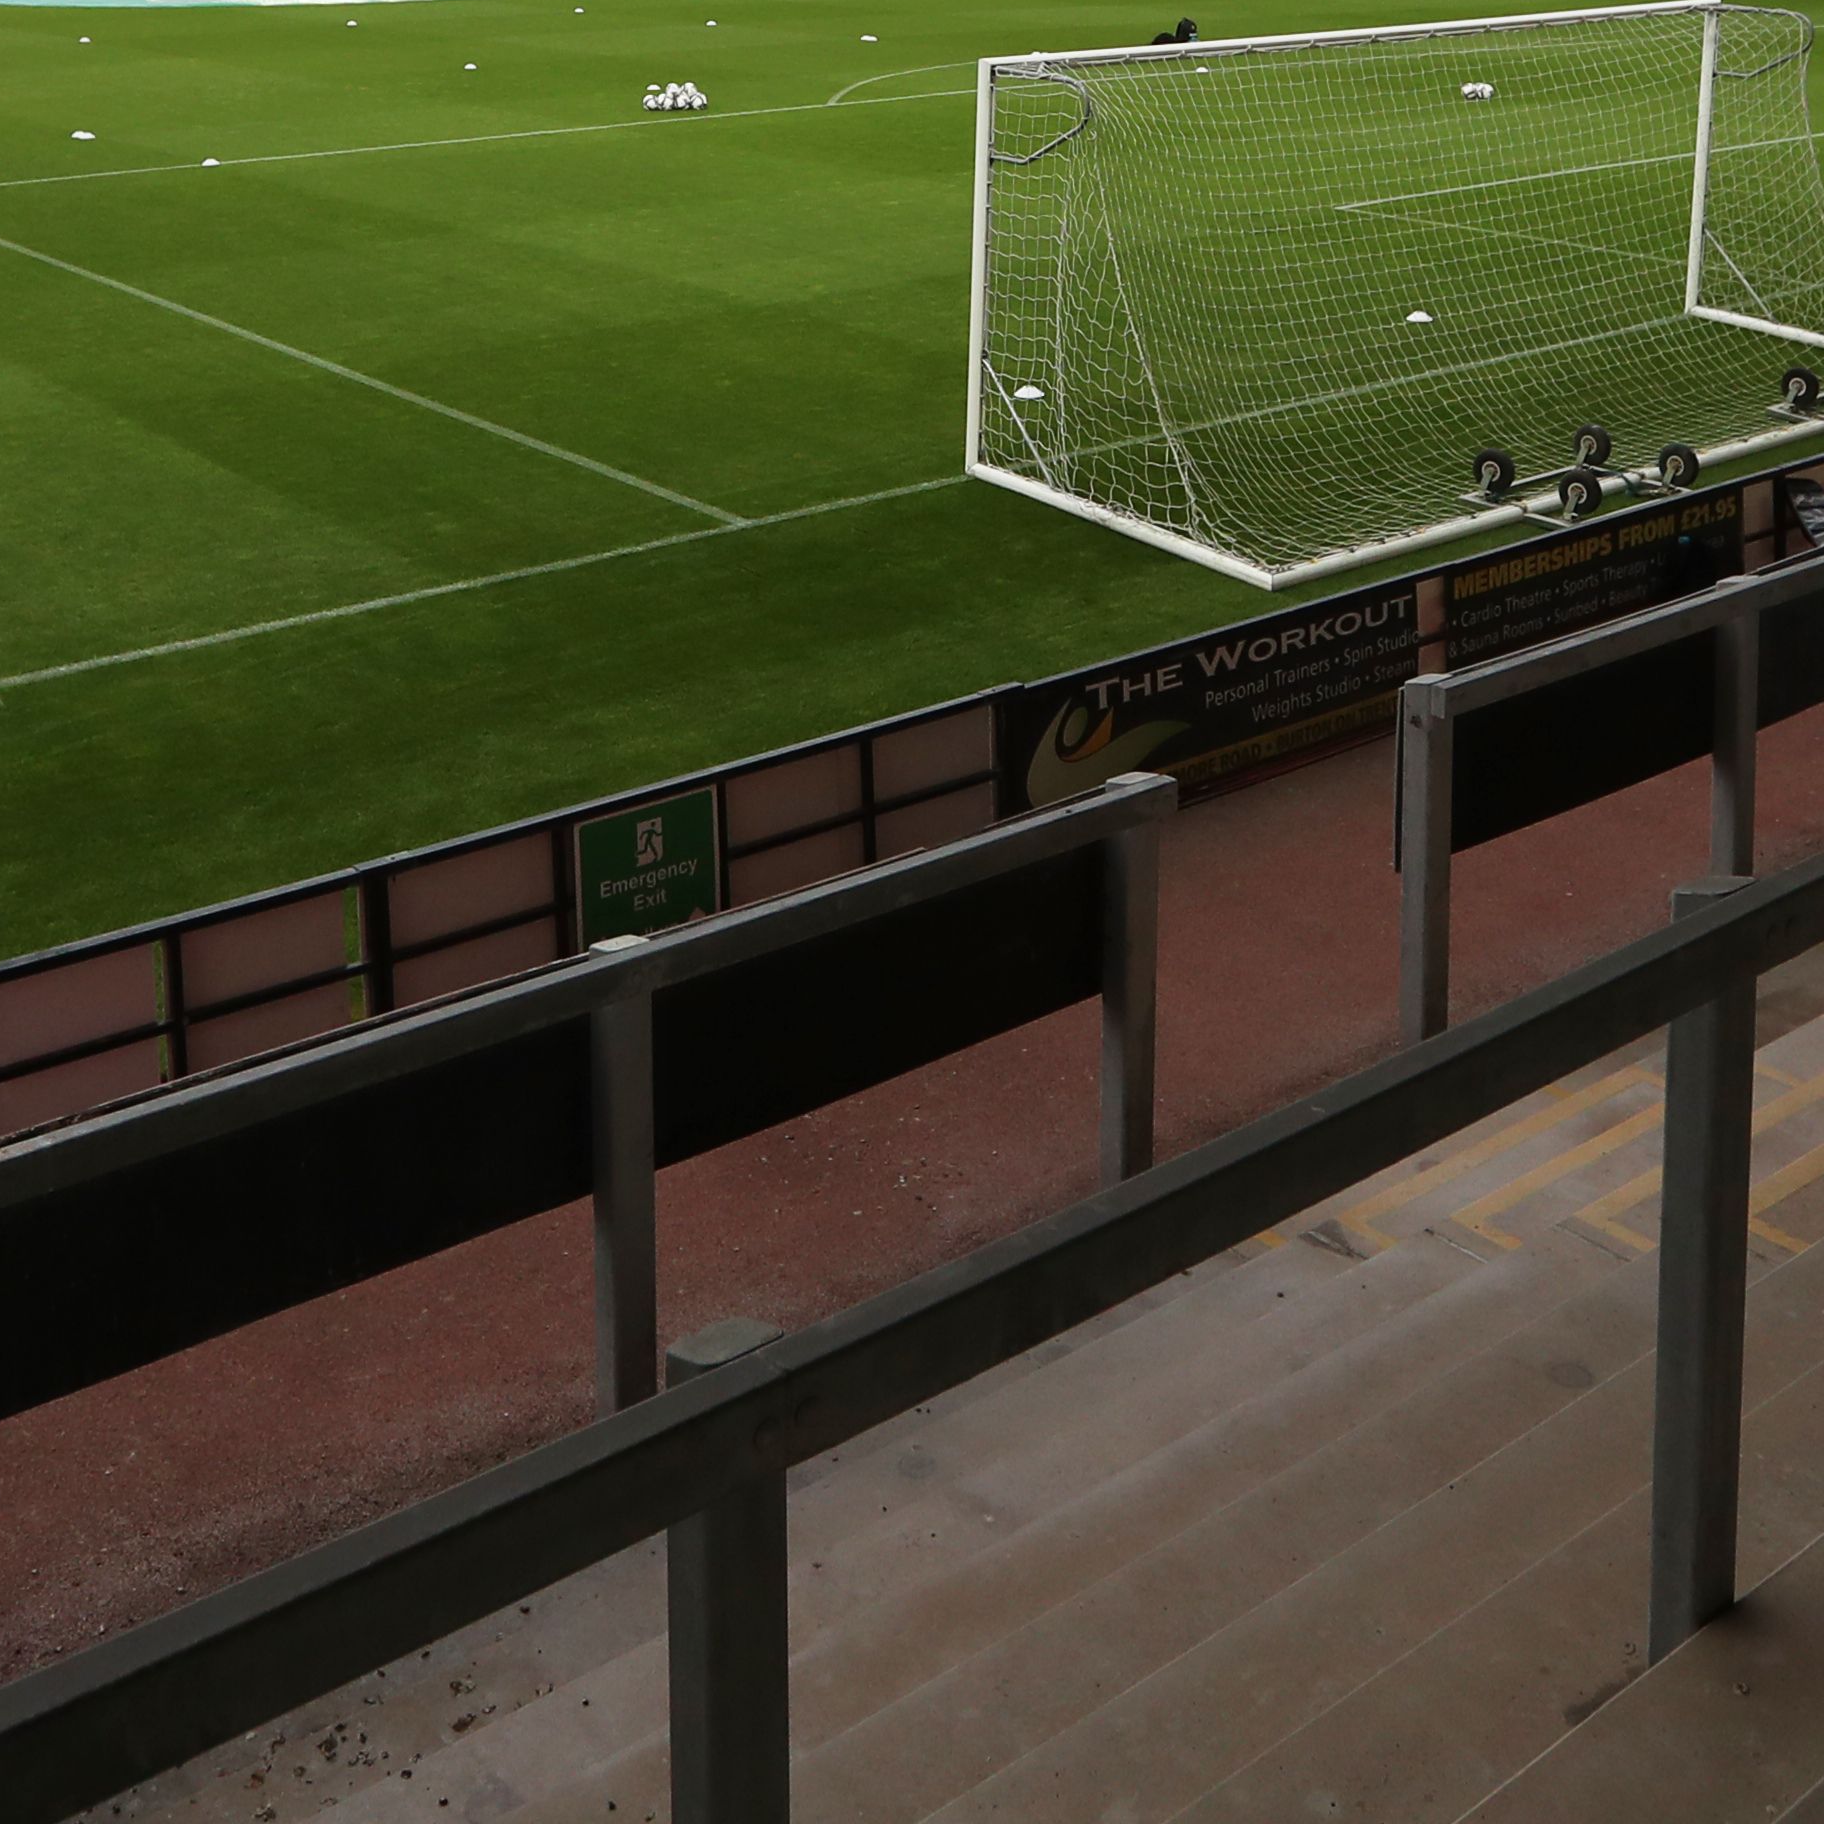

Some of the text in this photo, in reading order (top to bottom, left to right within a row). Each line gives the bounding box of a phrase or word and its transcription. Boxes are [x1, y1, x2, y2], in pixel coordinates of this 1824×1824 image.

[1453, 496, 1736, 600] MEMBERSHIPS FROM £21.95
[1461, 602, 1502, 628] Cardio
[1505, 587, 1552, 615] Theatre
[1562, 572, 1600, 598] Sports
[1602, 557, 1648, 586] Therapy
[1085, 594, 1413, 711] THE WORKOUT
[1448, 640, 1459, 658] &
[1461, 629, 1500, 656] Sauna
[1503, 614, 1544, 642] Rooms
[1554, 599, 1599, 625] Sunbed
[1205, 628, 1419, 709] Personal Trainers Spin Studio
[1252, 659, 1416, 724] Weights Studio Steam
[1220, 743, 1263, 775] ROAD
[600, 858, 698, 899] Emergency
[634, 888, 667, 911] Exit
